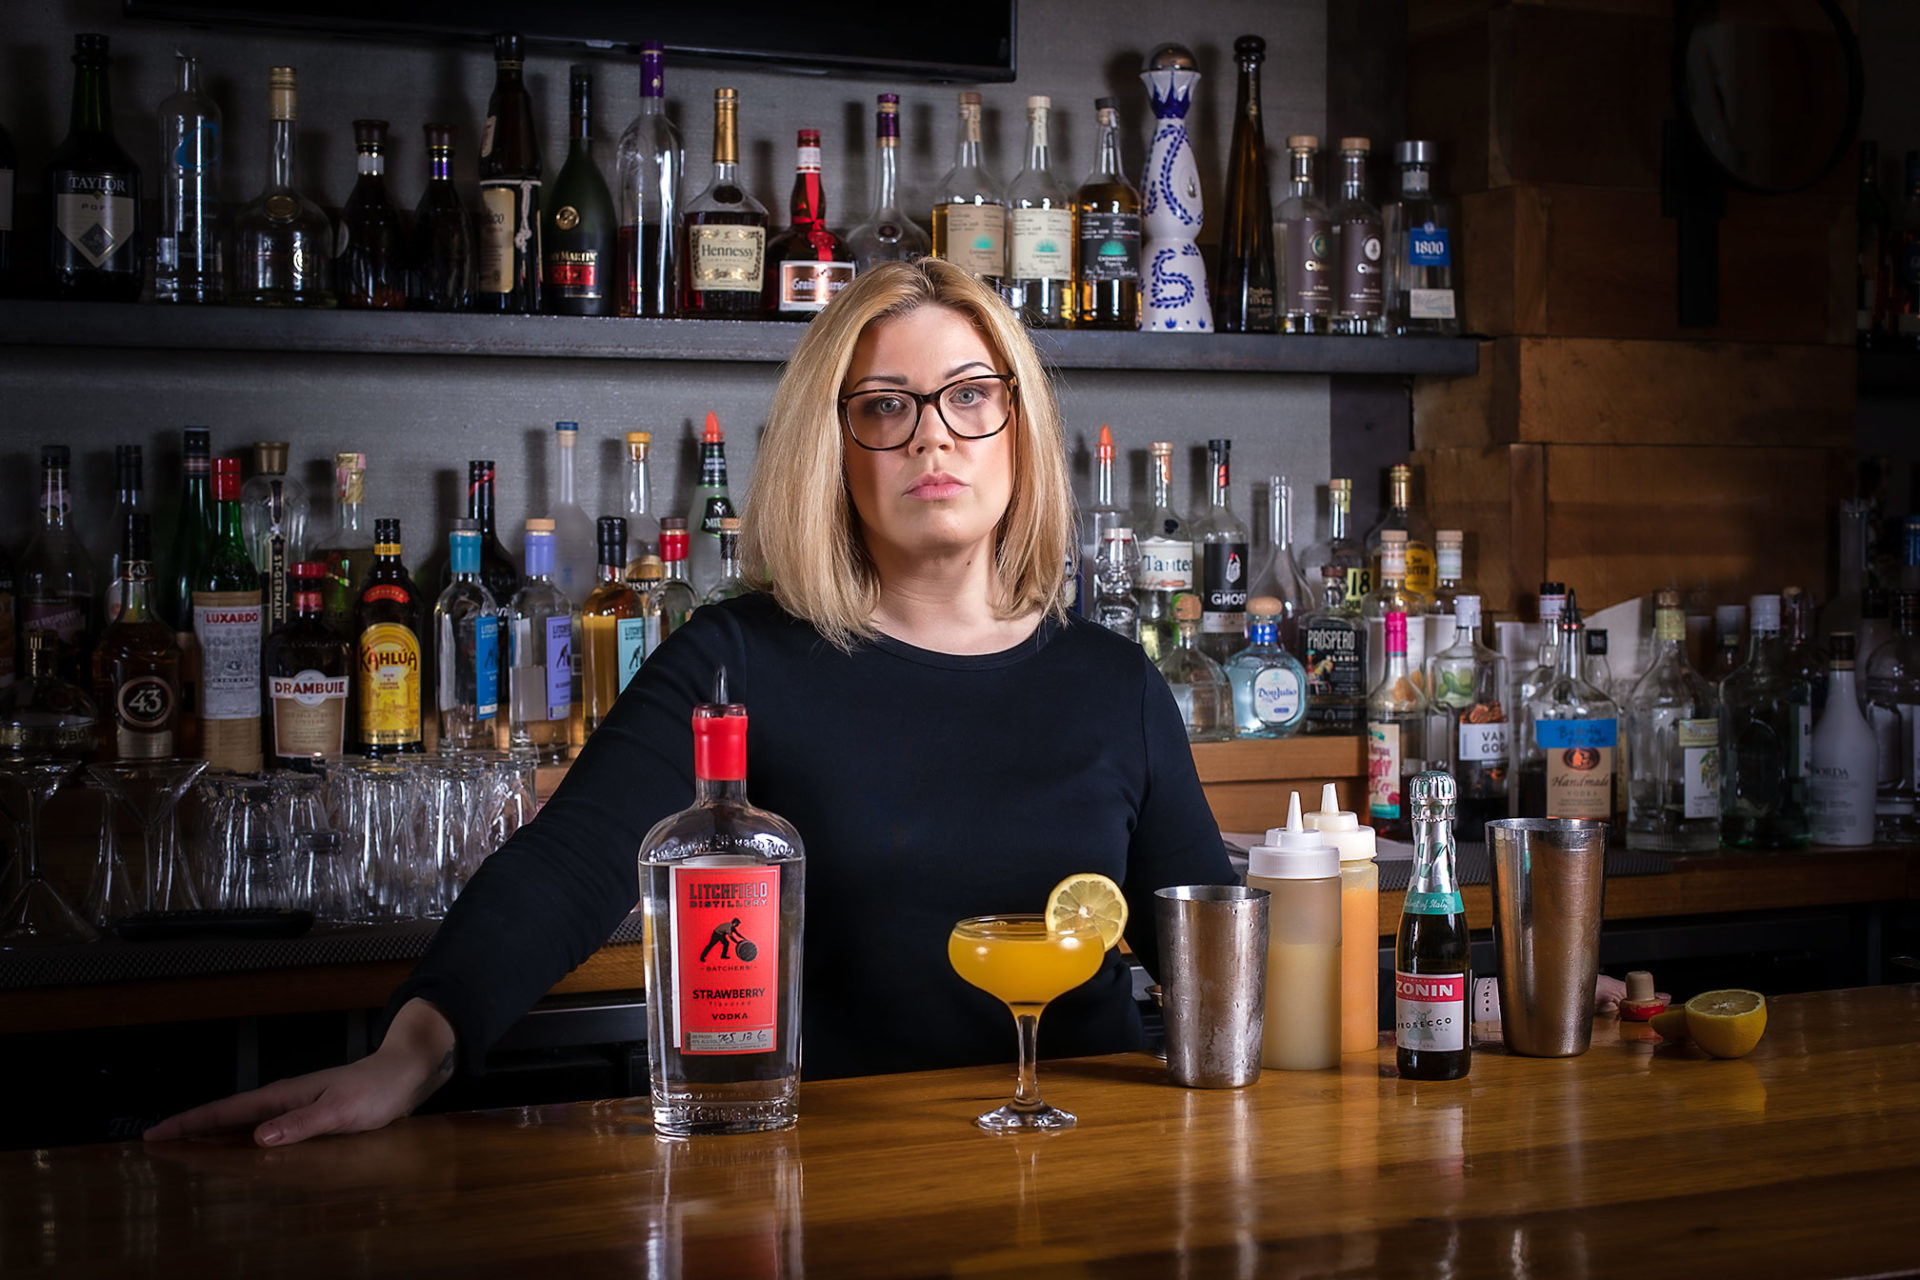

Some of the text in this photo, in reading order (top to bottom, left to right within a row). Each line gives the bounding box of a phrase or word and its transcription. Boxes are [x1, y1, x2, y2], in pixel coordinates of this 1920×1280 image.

[69, 176, 126, 192] TAYLOR
[701, 243, 753, 260] Hennessy
[1413, 240, 1445, 256] 1800
[205, 612, 259, 624] LUXARDO
[359, 643, 418, 672] KAHLÚA
[274, 681, 346, 695] DRAMBUIE
[128, 687, 163, 713] 43
[1551, 773, 1610, 788] Handmade
[689, 882, 768, 900] LITCHFIELD
[690, 900, 768, 908] DISTILLERY
[692, 987, 766, 1000] STRAWBERRY
[711, 1012, 749, 1021] VODKA
